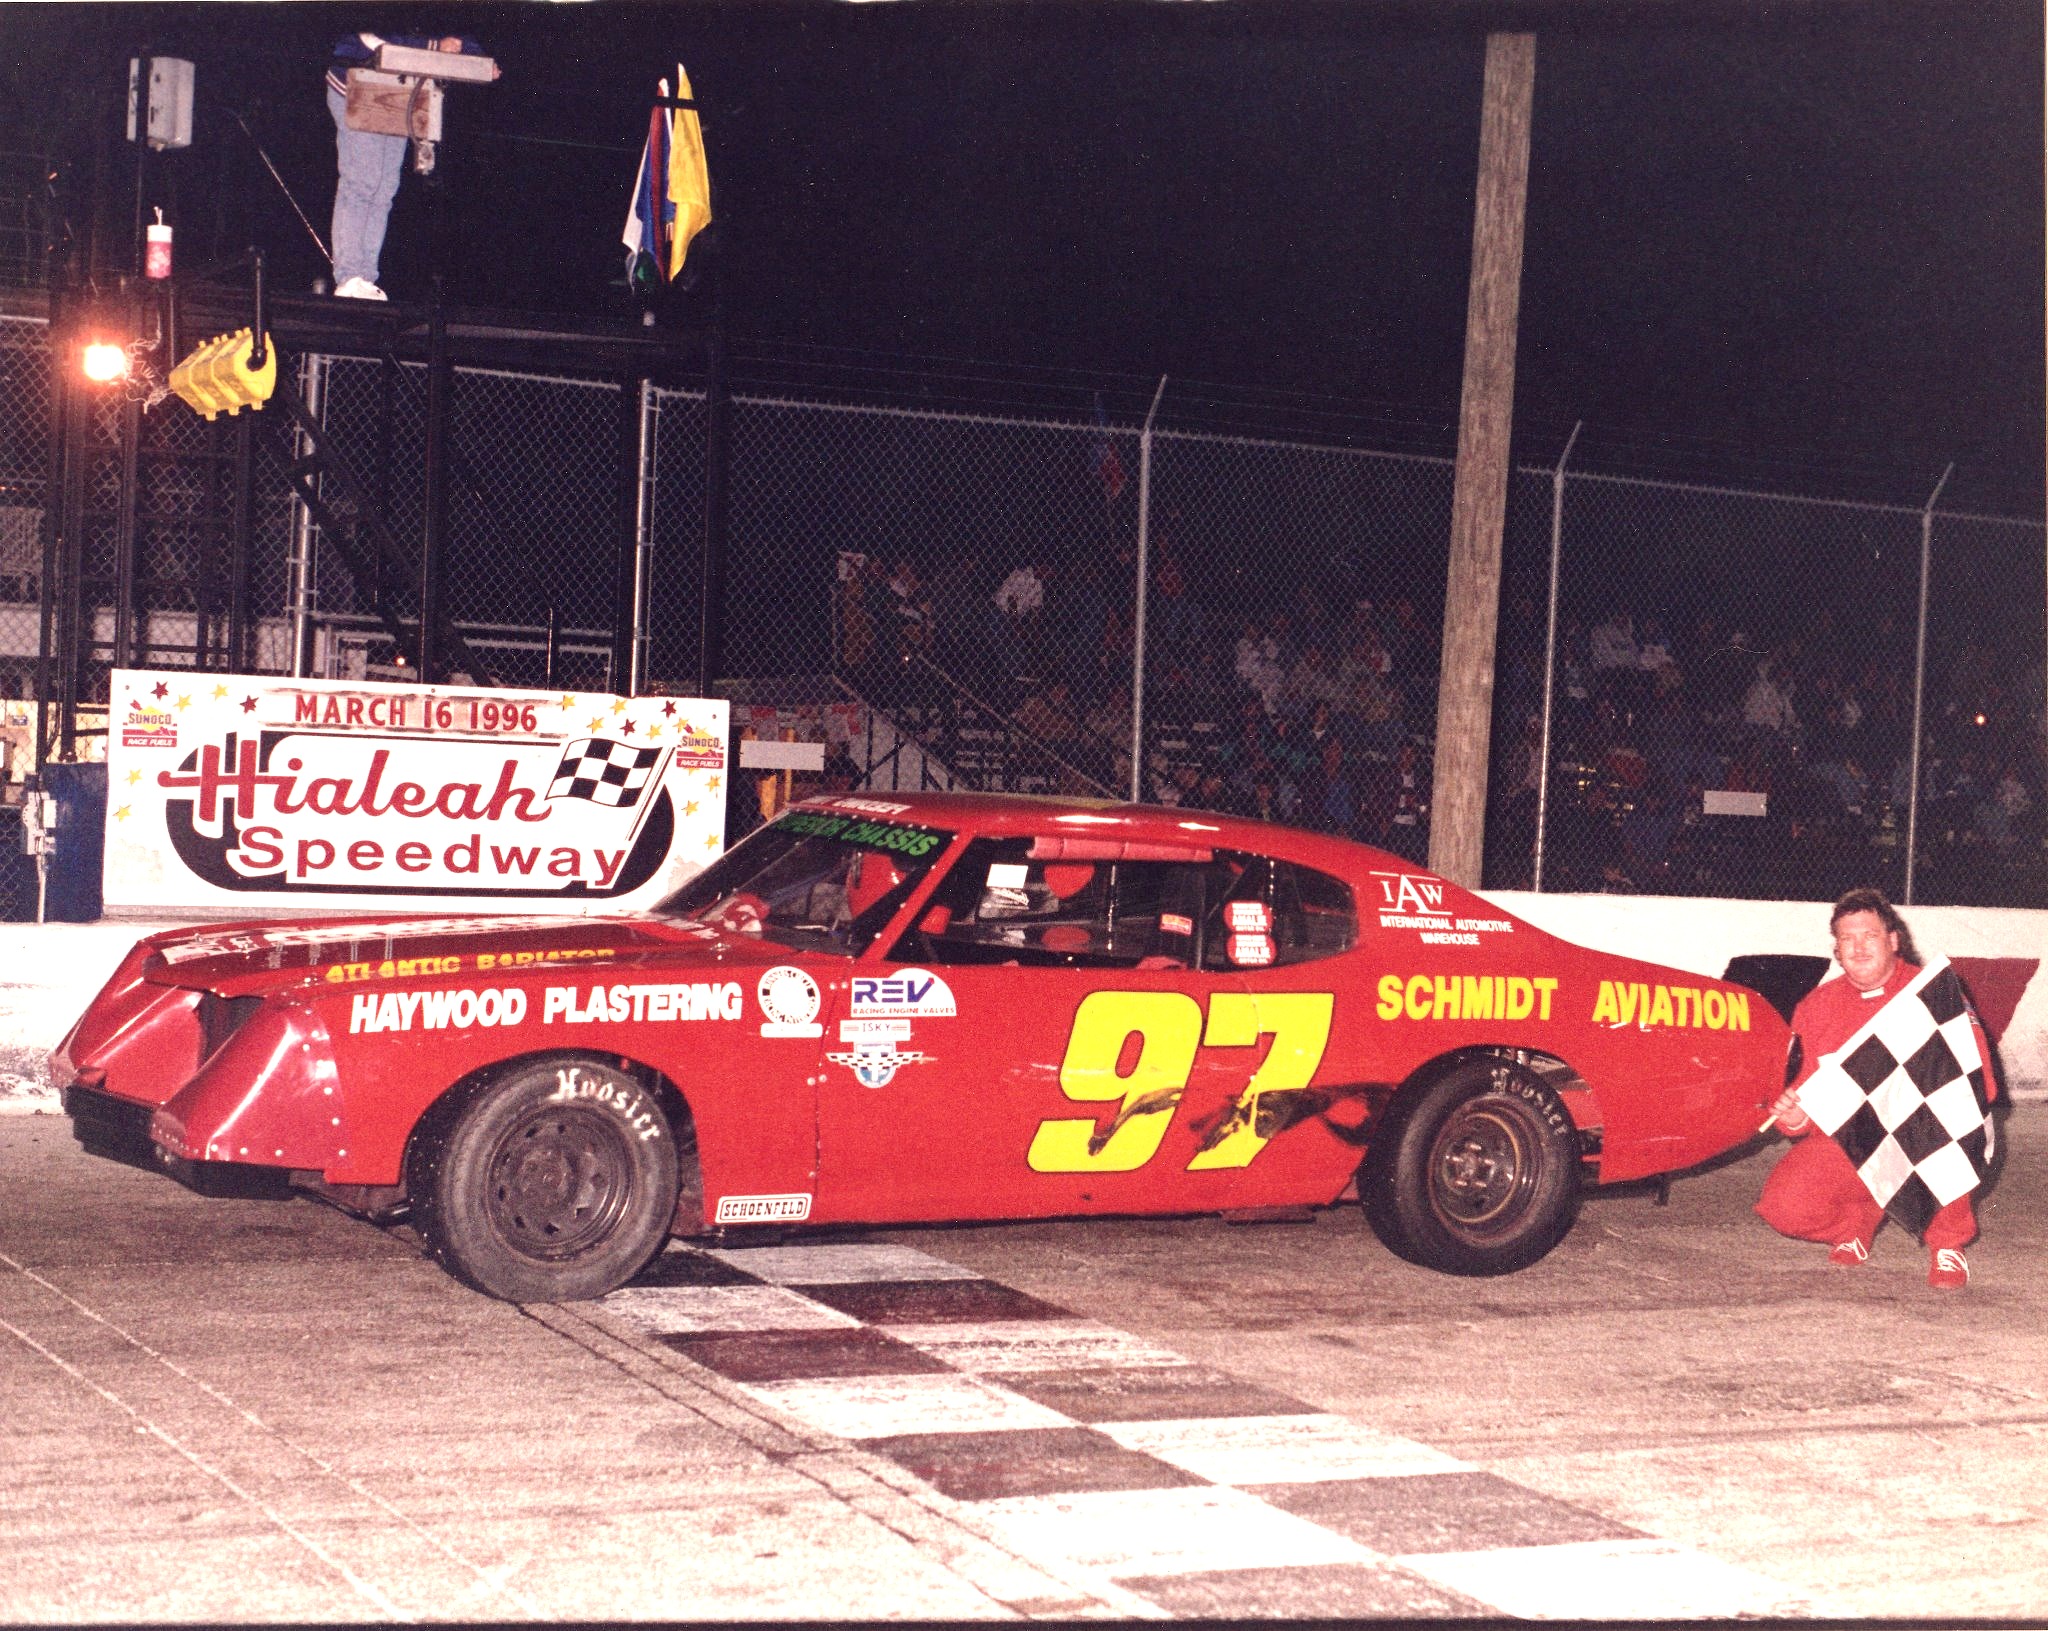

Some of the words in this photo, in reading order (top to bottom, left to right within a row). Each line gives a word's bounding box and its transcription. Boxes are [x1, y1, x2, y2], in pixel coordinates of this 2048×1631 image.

[128, 712, 172, 725] SUNOCO
[295, 694, 407, 727] MARCH
[423, 700, 453, 729] 16
[470, 701, 538, 732] 1996
[681, 735, 720, 748] SUNOCO
[680, 759, 699, 767] RACE
[699, 760, 721, 768] FUELS
[157, 740, 553, 823] Hialeah
[841, 822, 940, 857] CHASSIS
[238, 825, 627, 887] Speedway
[1380, 873, 1443, 914] IAW
[1379, 915, 1454, 930] INTERNATIONAL
[1455, 918, 1515, 933] AUTOMOTIVE
[1419, 931, 1481, 946] WAREHOUSE
[325, 956, 461, 984] ATLANTIC
[853, 976, 936, 1004] REV
[1376, 974, 1559, 1021] SCHMIDT
[1592, 980, 1751, 1032] AVIATION
[350, 988, 527, 1034] HAYWOOD
[543, 982, 742, 1025] PLASTERING
[853, 1007, 885, 1015] RACING
[888, 1007, 919, 1015] ENGINE
[862, 1022, 891, 1032] ISKY
[1027, 990, 1335, 1173] 97
[546, 1067, 661, 1141] Hoosier
[724, 1201, 804, 1217] SCHOENFELD
